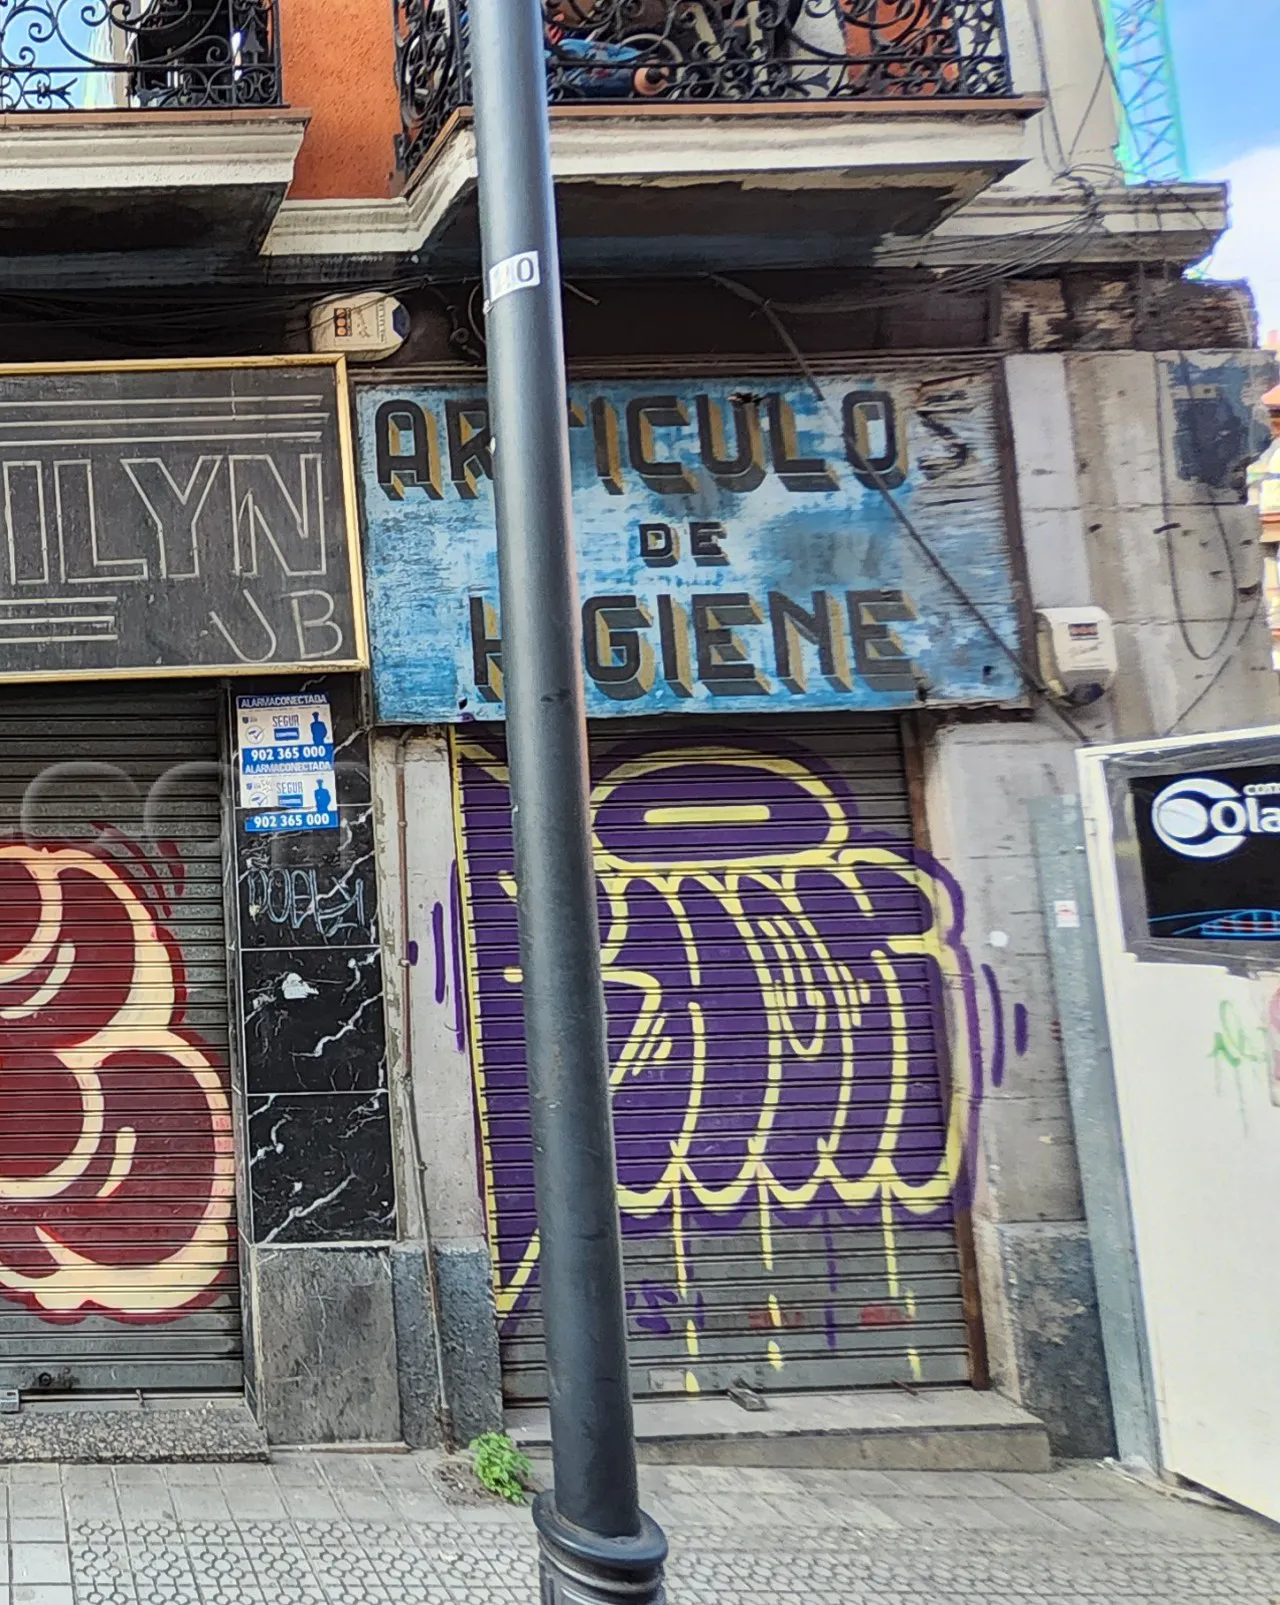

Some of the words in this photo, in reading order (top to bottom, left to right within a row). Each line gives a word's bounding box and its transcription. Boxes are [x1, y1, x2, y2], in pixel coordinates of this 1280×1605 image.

[375, 388, 969, 500] ARICULOS
[639, 521, 729, 567] DE
[469, 589, 920, 703] HGIENE
[251, 749, 274, 761] 902
[277, 747, 300, 760] 365
[303, 745, 326, 758] 000
[254, 815, 277, 829] 902
[280, 814, 303, 827] 365
[306, 812, 329, 826] 000
